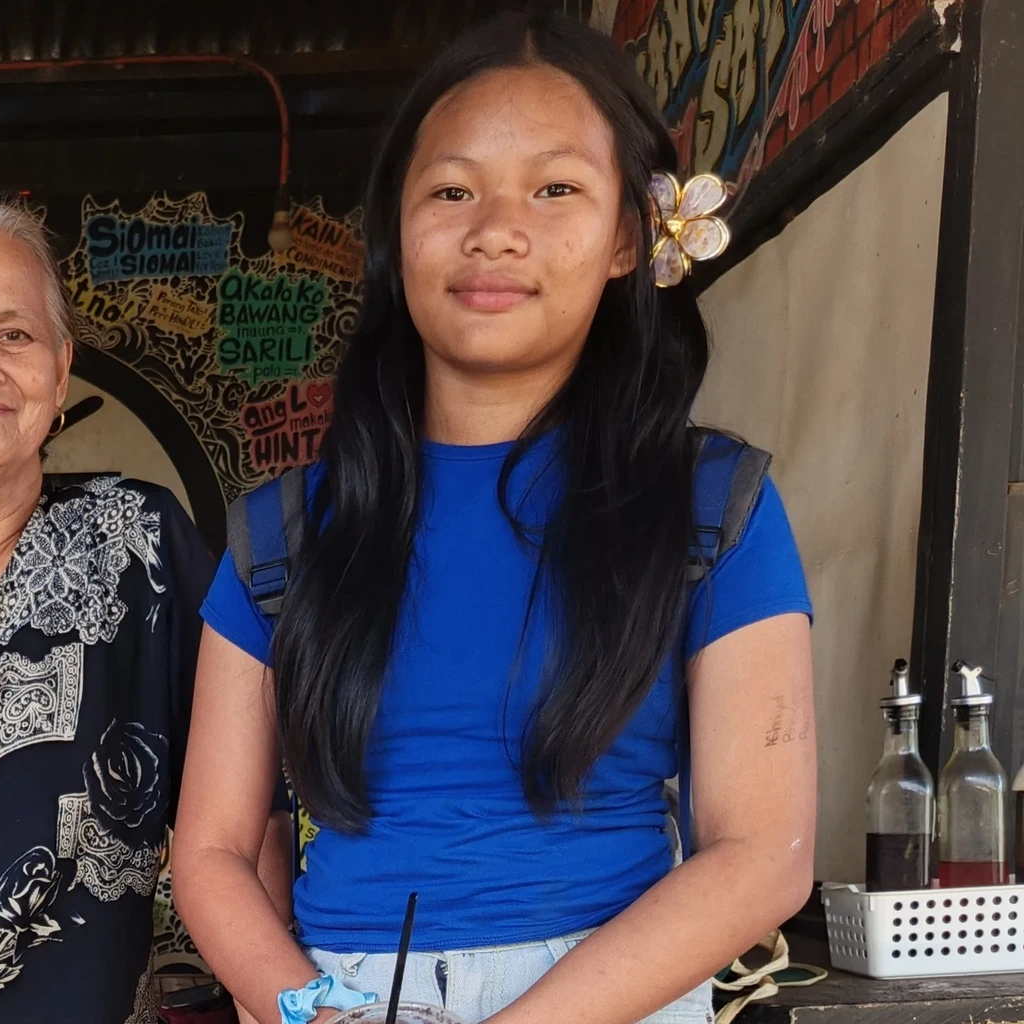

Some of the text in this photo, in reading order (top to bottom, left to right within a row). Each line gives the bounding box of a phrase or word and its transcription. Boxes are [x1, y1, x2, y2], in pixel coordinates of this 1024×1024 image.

[220, 303, 320, 326] BAWANG
[219, 337, 312, 365] SARILI
[245, 401, 288, 437] ang
[255, 429, 322, 467] HINT
